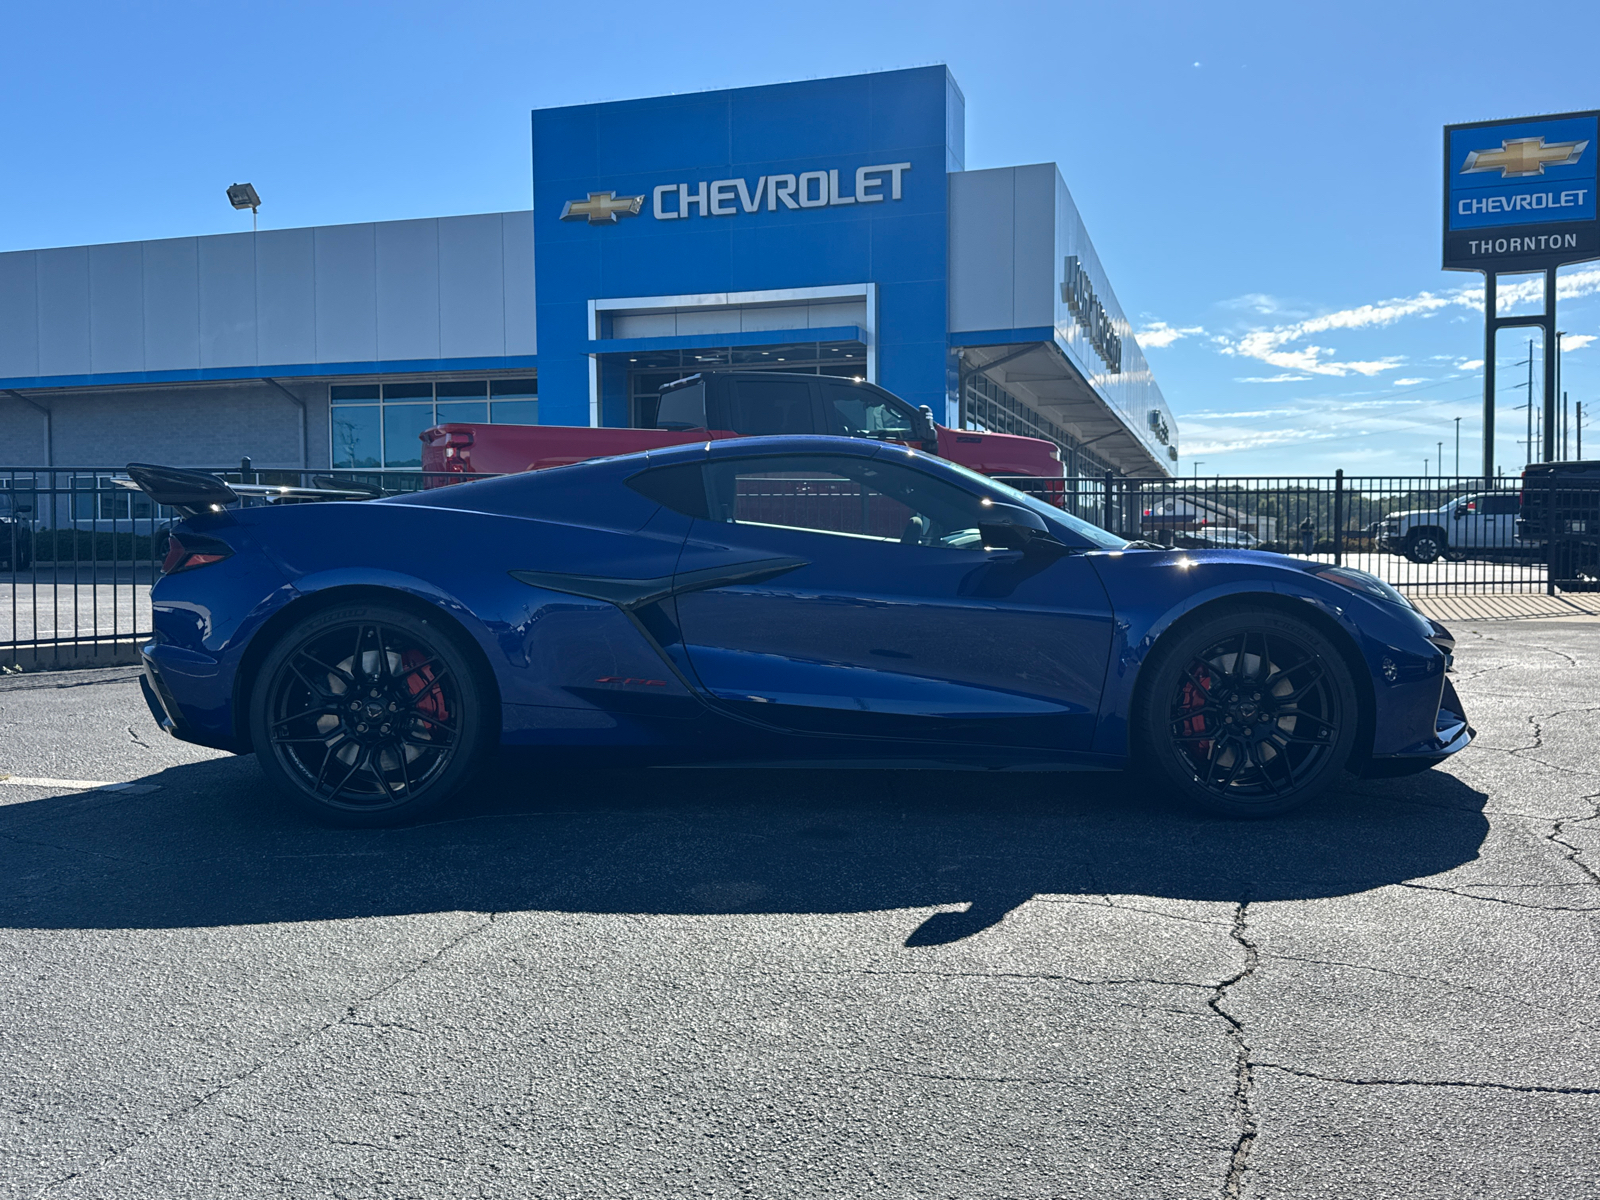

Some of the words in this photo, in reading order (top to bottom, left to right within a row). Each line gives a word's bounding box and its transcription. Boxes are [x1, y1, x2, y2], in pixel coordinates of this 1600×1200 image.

[652, 162, 911, 220] CHEVROLET
[1458, 189, 1588, 215] CHEVROLET
[1469, 233, 1577, 255] THORNTON
